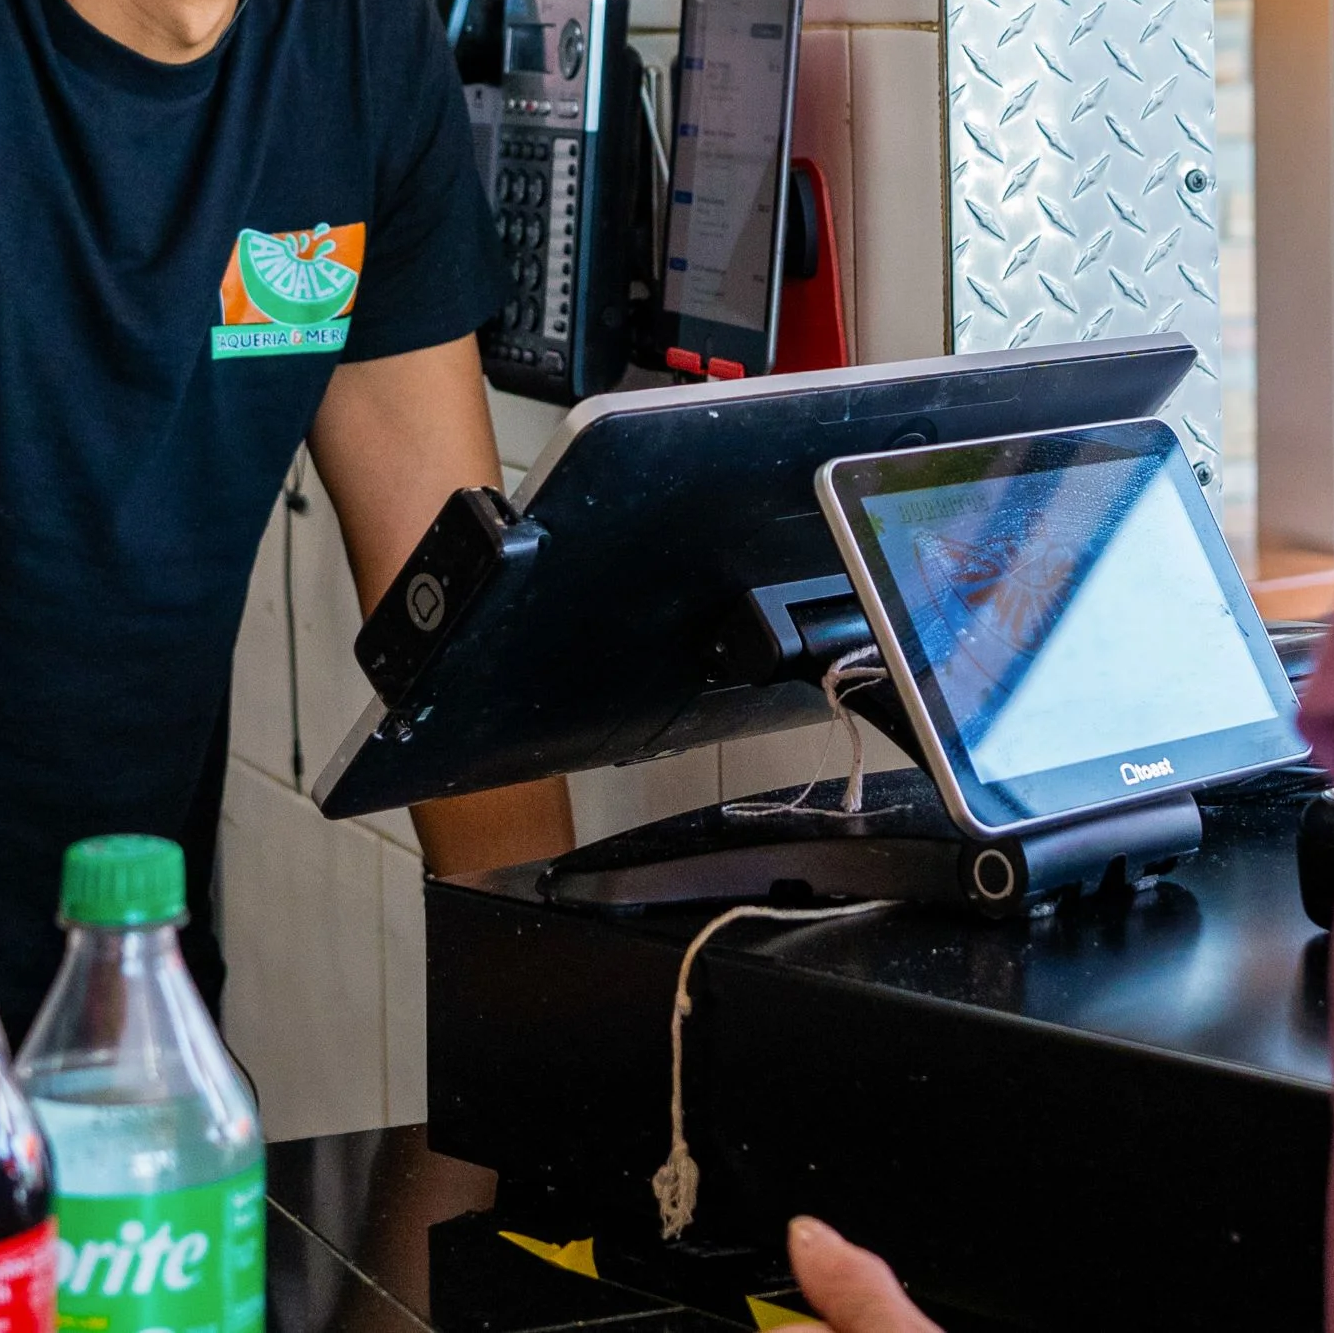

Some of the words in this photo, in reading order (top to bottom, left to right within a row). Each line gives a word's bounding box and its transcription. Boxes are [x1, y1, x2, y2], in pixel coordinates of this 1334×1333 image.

[249, 234, 351, 300] ANDALE
[1134, 756, 1175, 782] toast
[57, 1220, 209, 1296] rite
